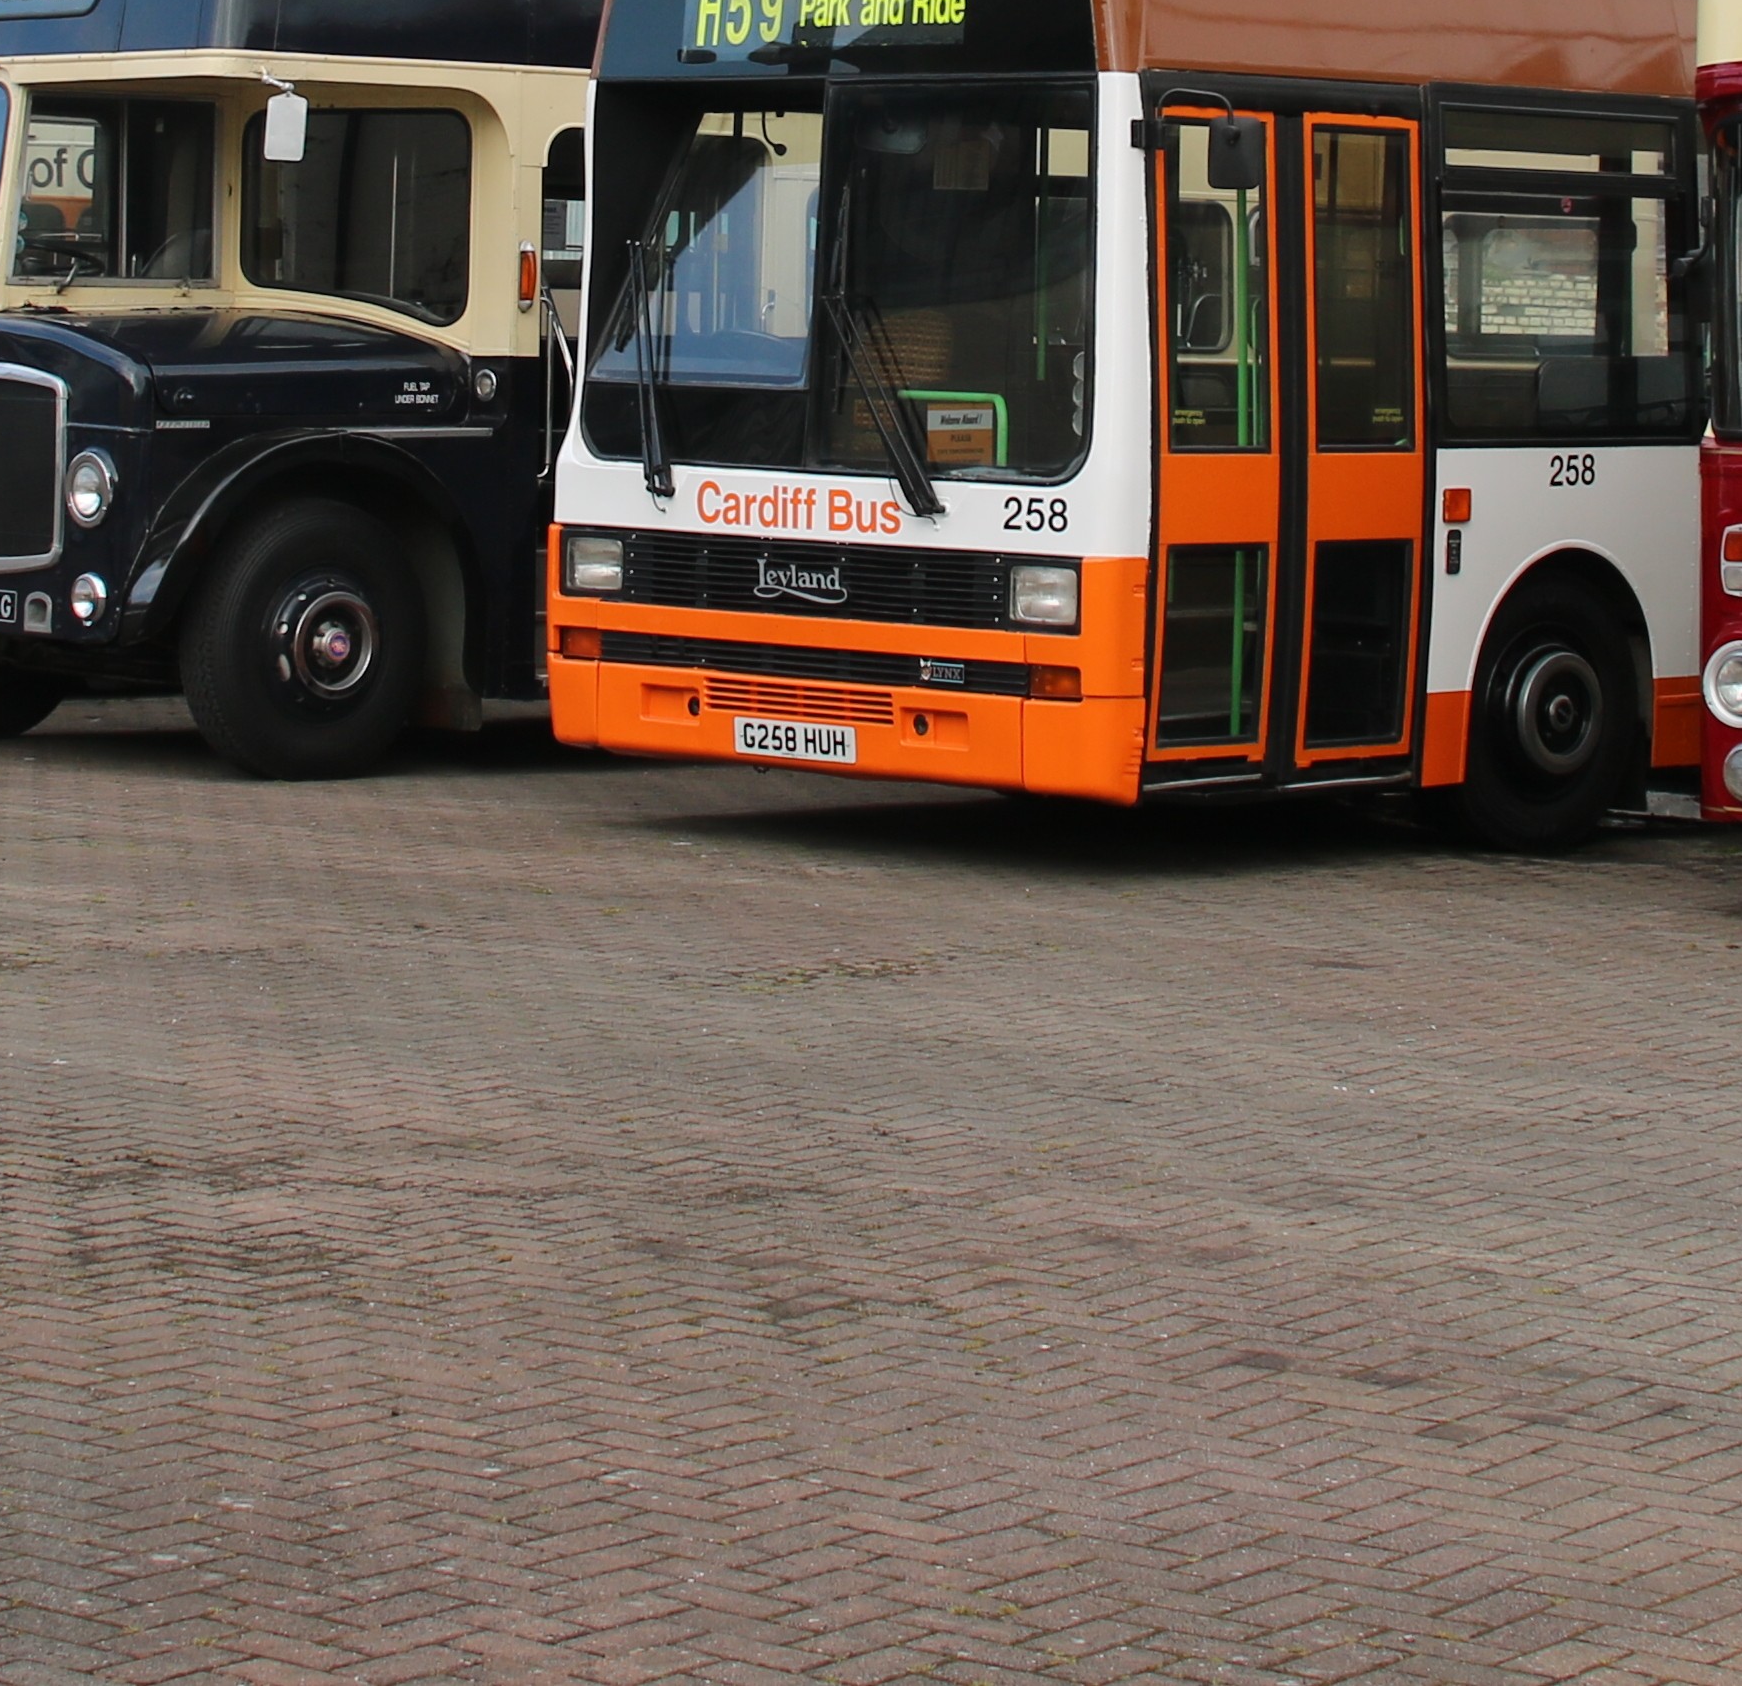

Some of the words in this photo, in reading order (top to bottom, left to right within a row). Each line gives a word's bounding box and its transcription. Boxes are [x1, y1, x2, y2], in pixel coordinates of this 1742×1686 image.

[30, 148, 67, 188] of
[1549, 453, 1596, 487] 258
[697, 479, 817, 531] Cardiff
[827, 489, 902, 535] Bus
[1003, 496, 1069, 532] 258
[753, 558, 848, 604] Leyland
[931, 664, 962, 681] LYNX
[743, 722, 797, 753] G258
[803, 726, 846, 757] HUH
